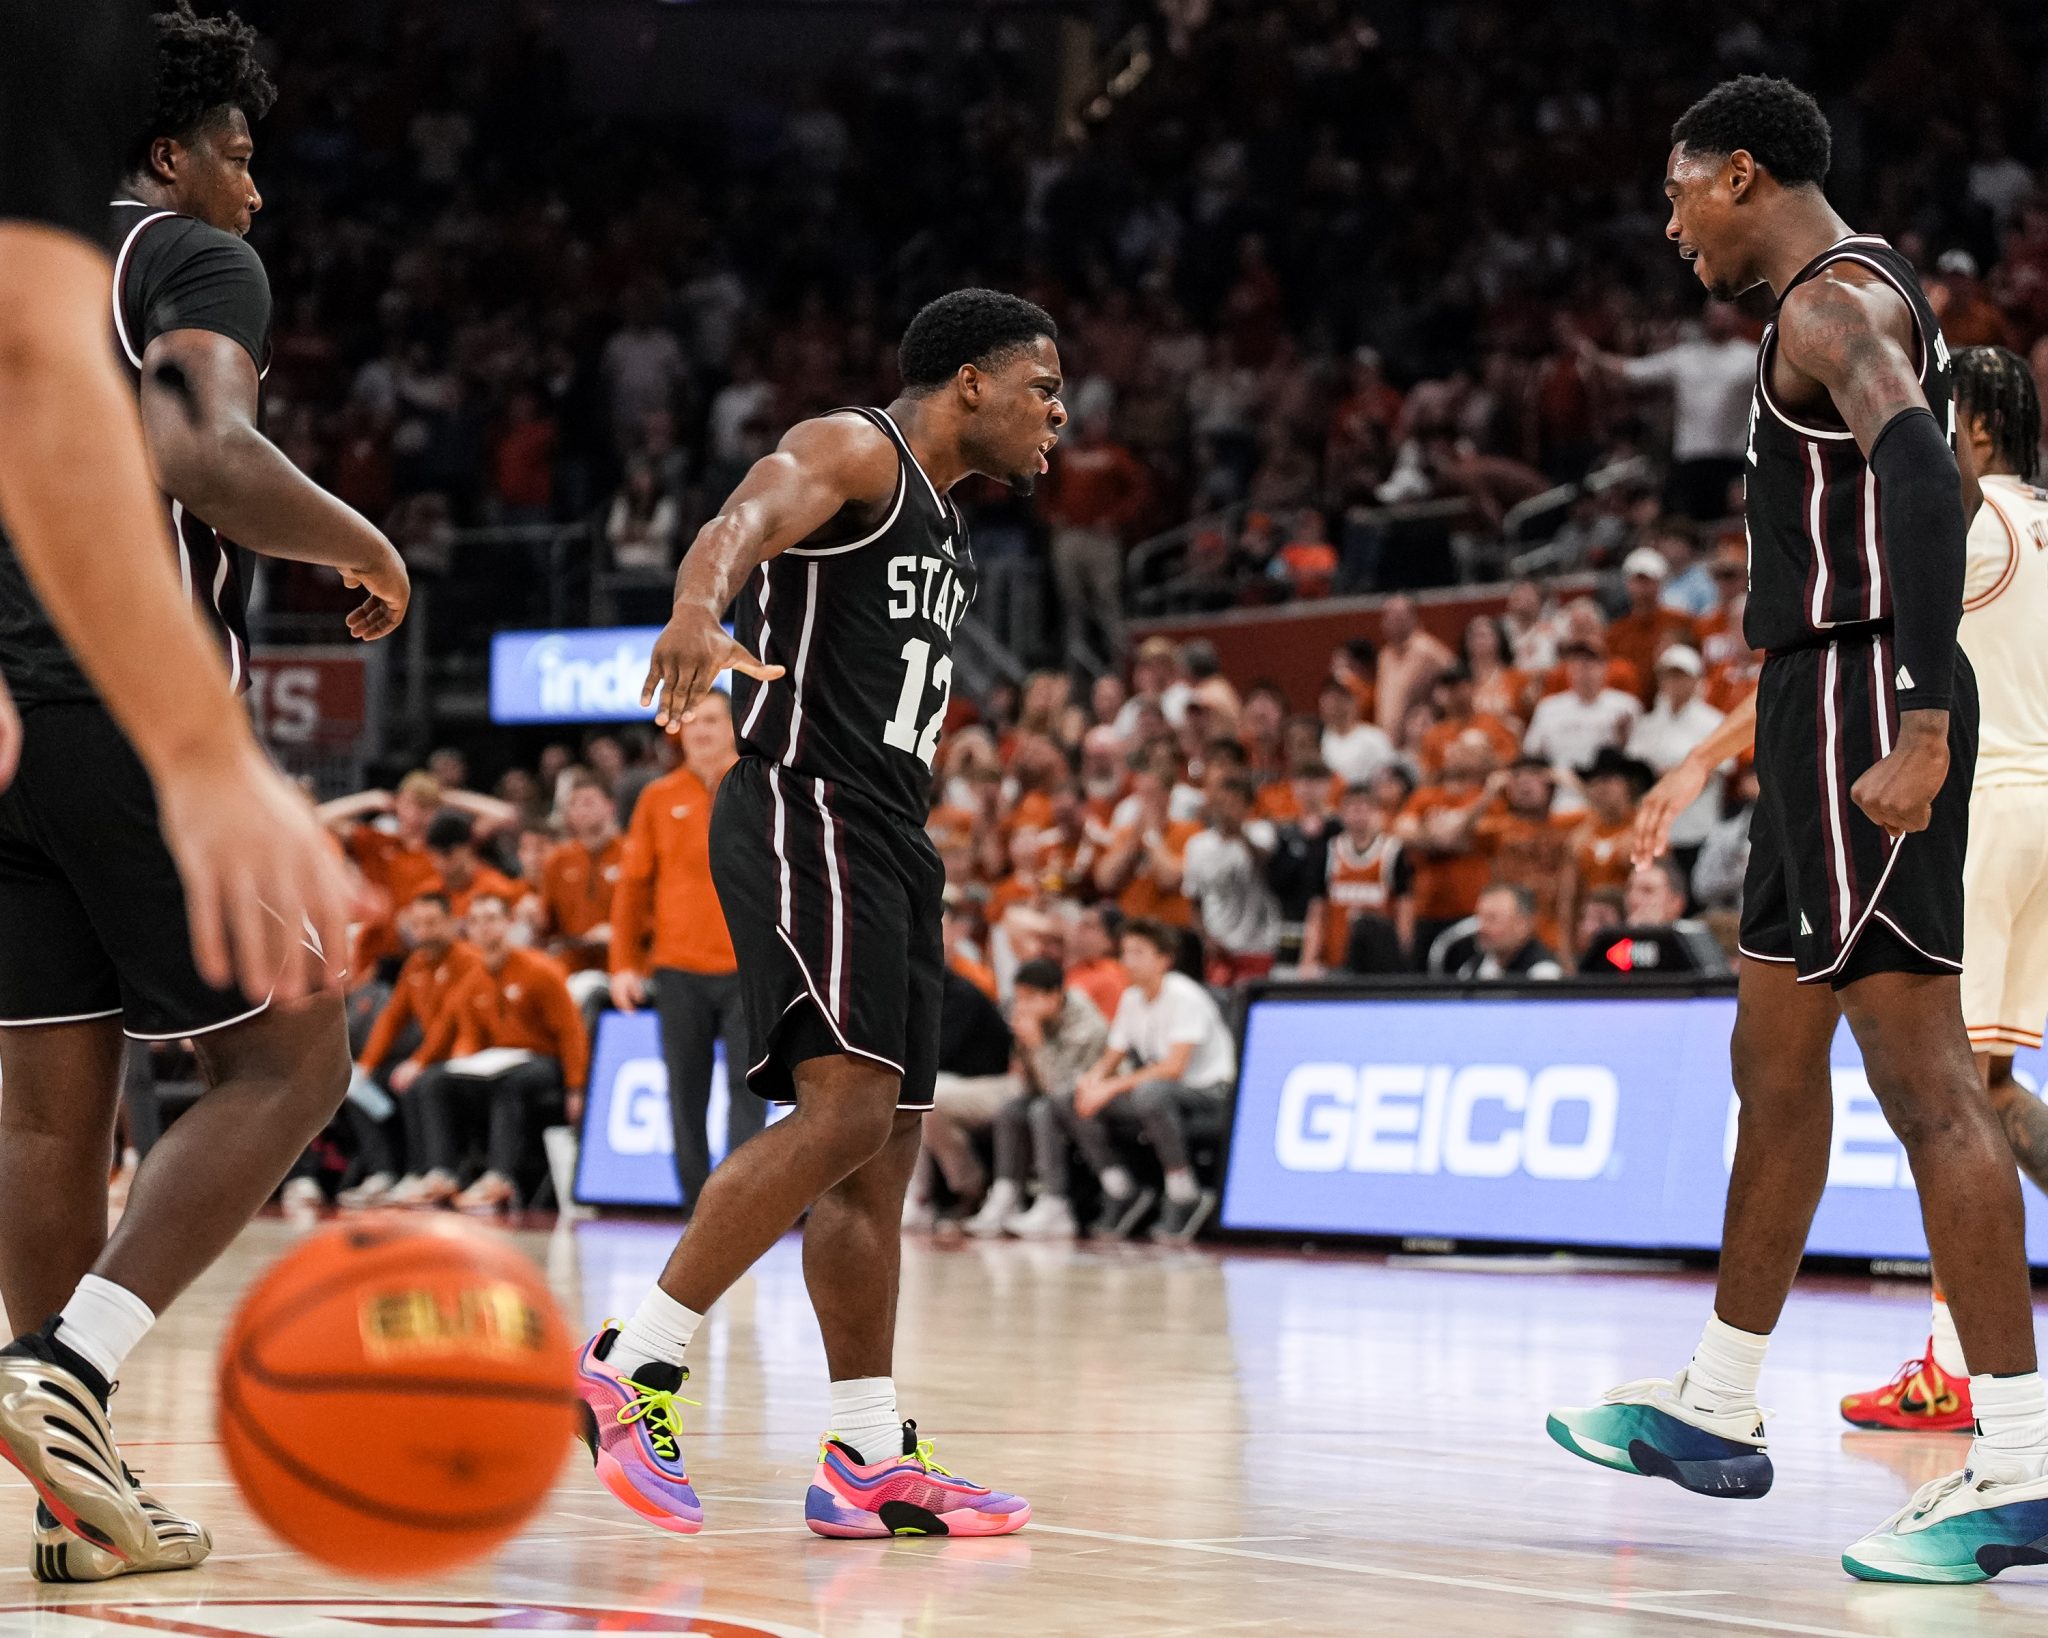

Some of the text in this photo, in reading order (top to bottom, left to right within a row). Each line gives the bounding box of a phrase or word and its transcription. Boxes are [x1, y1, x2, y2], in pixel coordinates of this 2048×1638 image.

[888, 556, 969, 642] STAT
[883, 638, 954, 776] 12
[1275, 1062, 1620, 1180] GEICO
